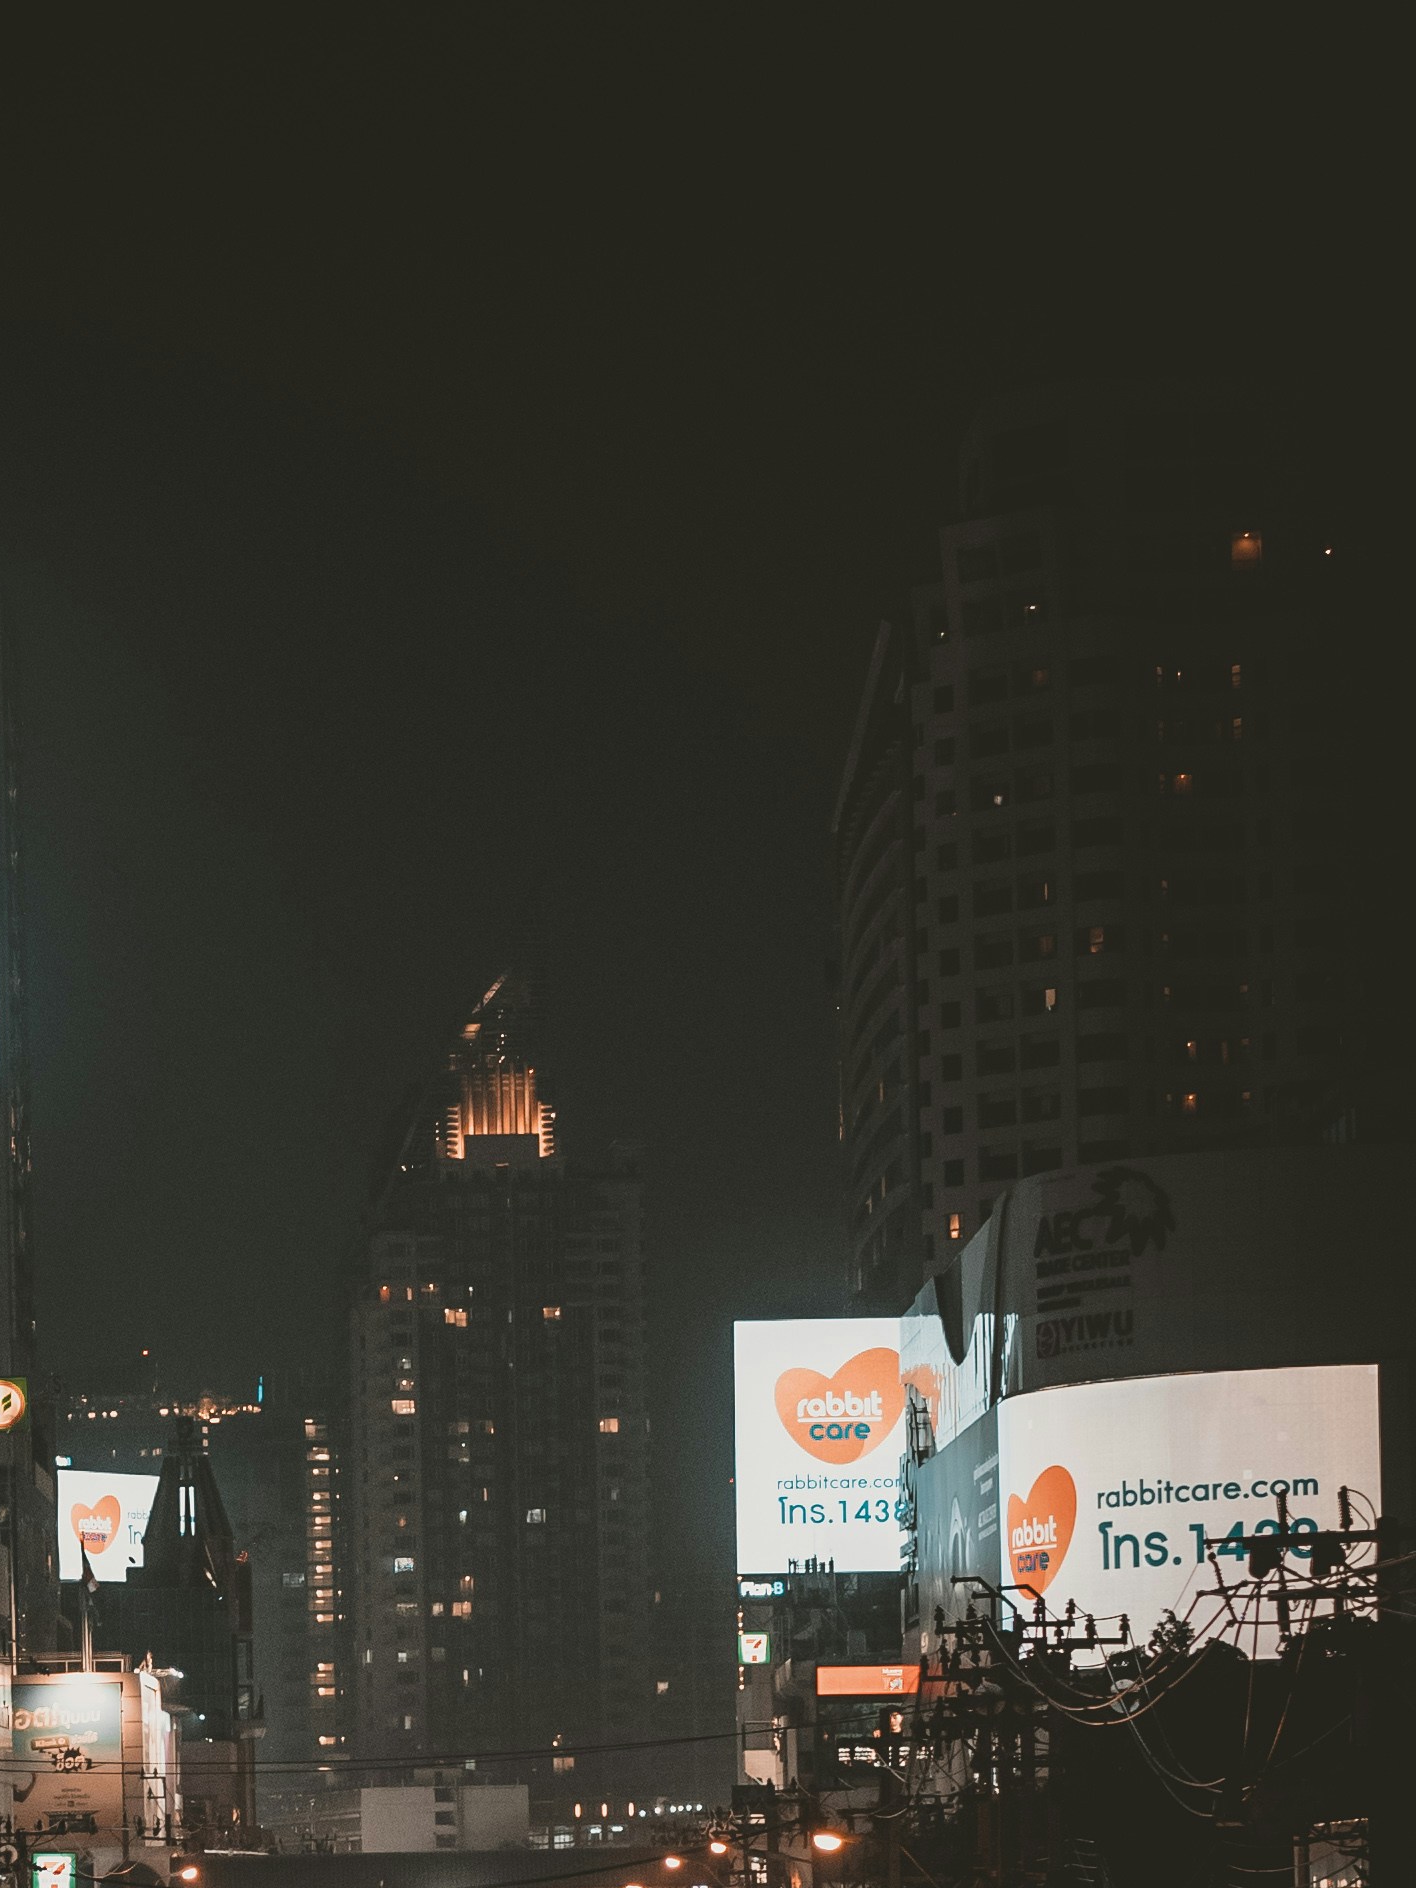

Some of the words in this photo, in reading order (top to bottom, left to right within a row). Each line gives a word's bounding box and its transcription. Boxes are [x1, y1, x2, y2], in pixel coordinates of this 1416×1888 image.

[797, 1390, 883, 1418] rabbit
[809, 1422, 871, 1441] care
[1097, 1477, 1320, 1510] rabbitcare.com
[1012, 1515, 1058, 1550] rabbit
[1017, 1551, 1050, 1574] care
